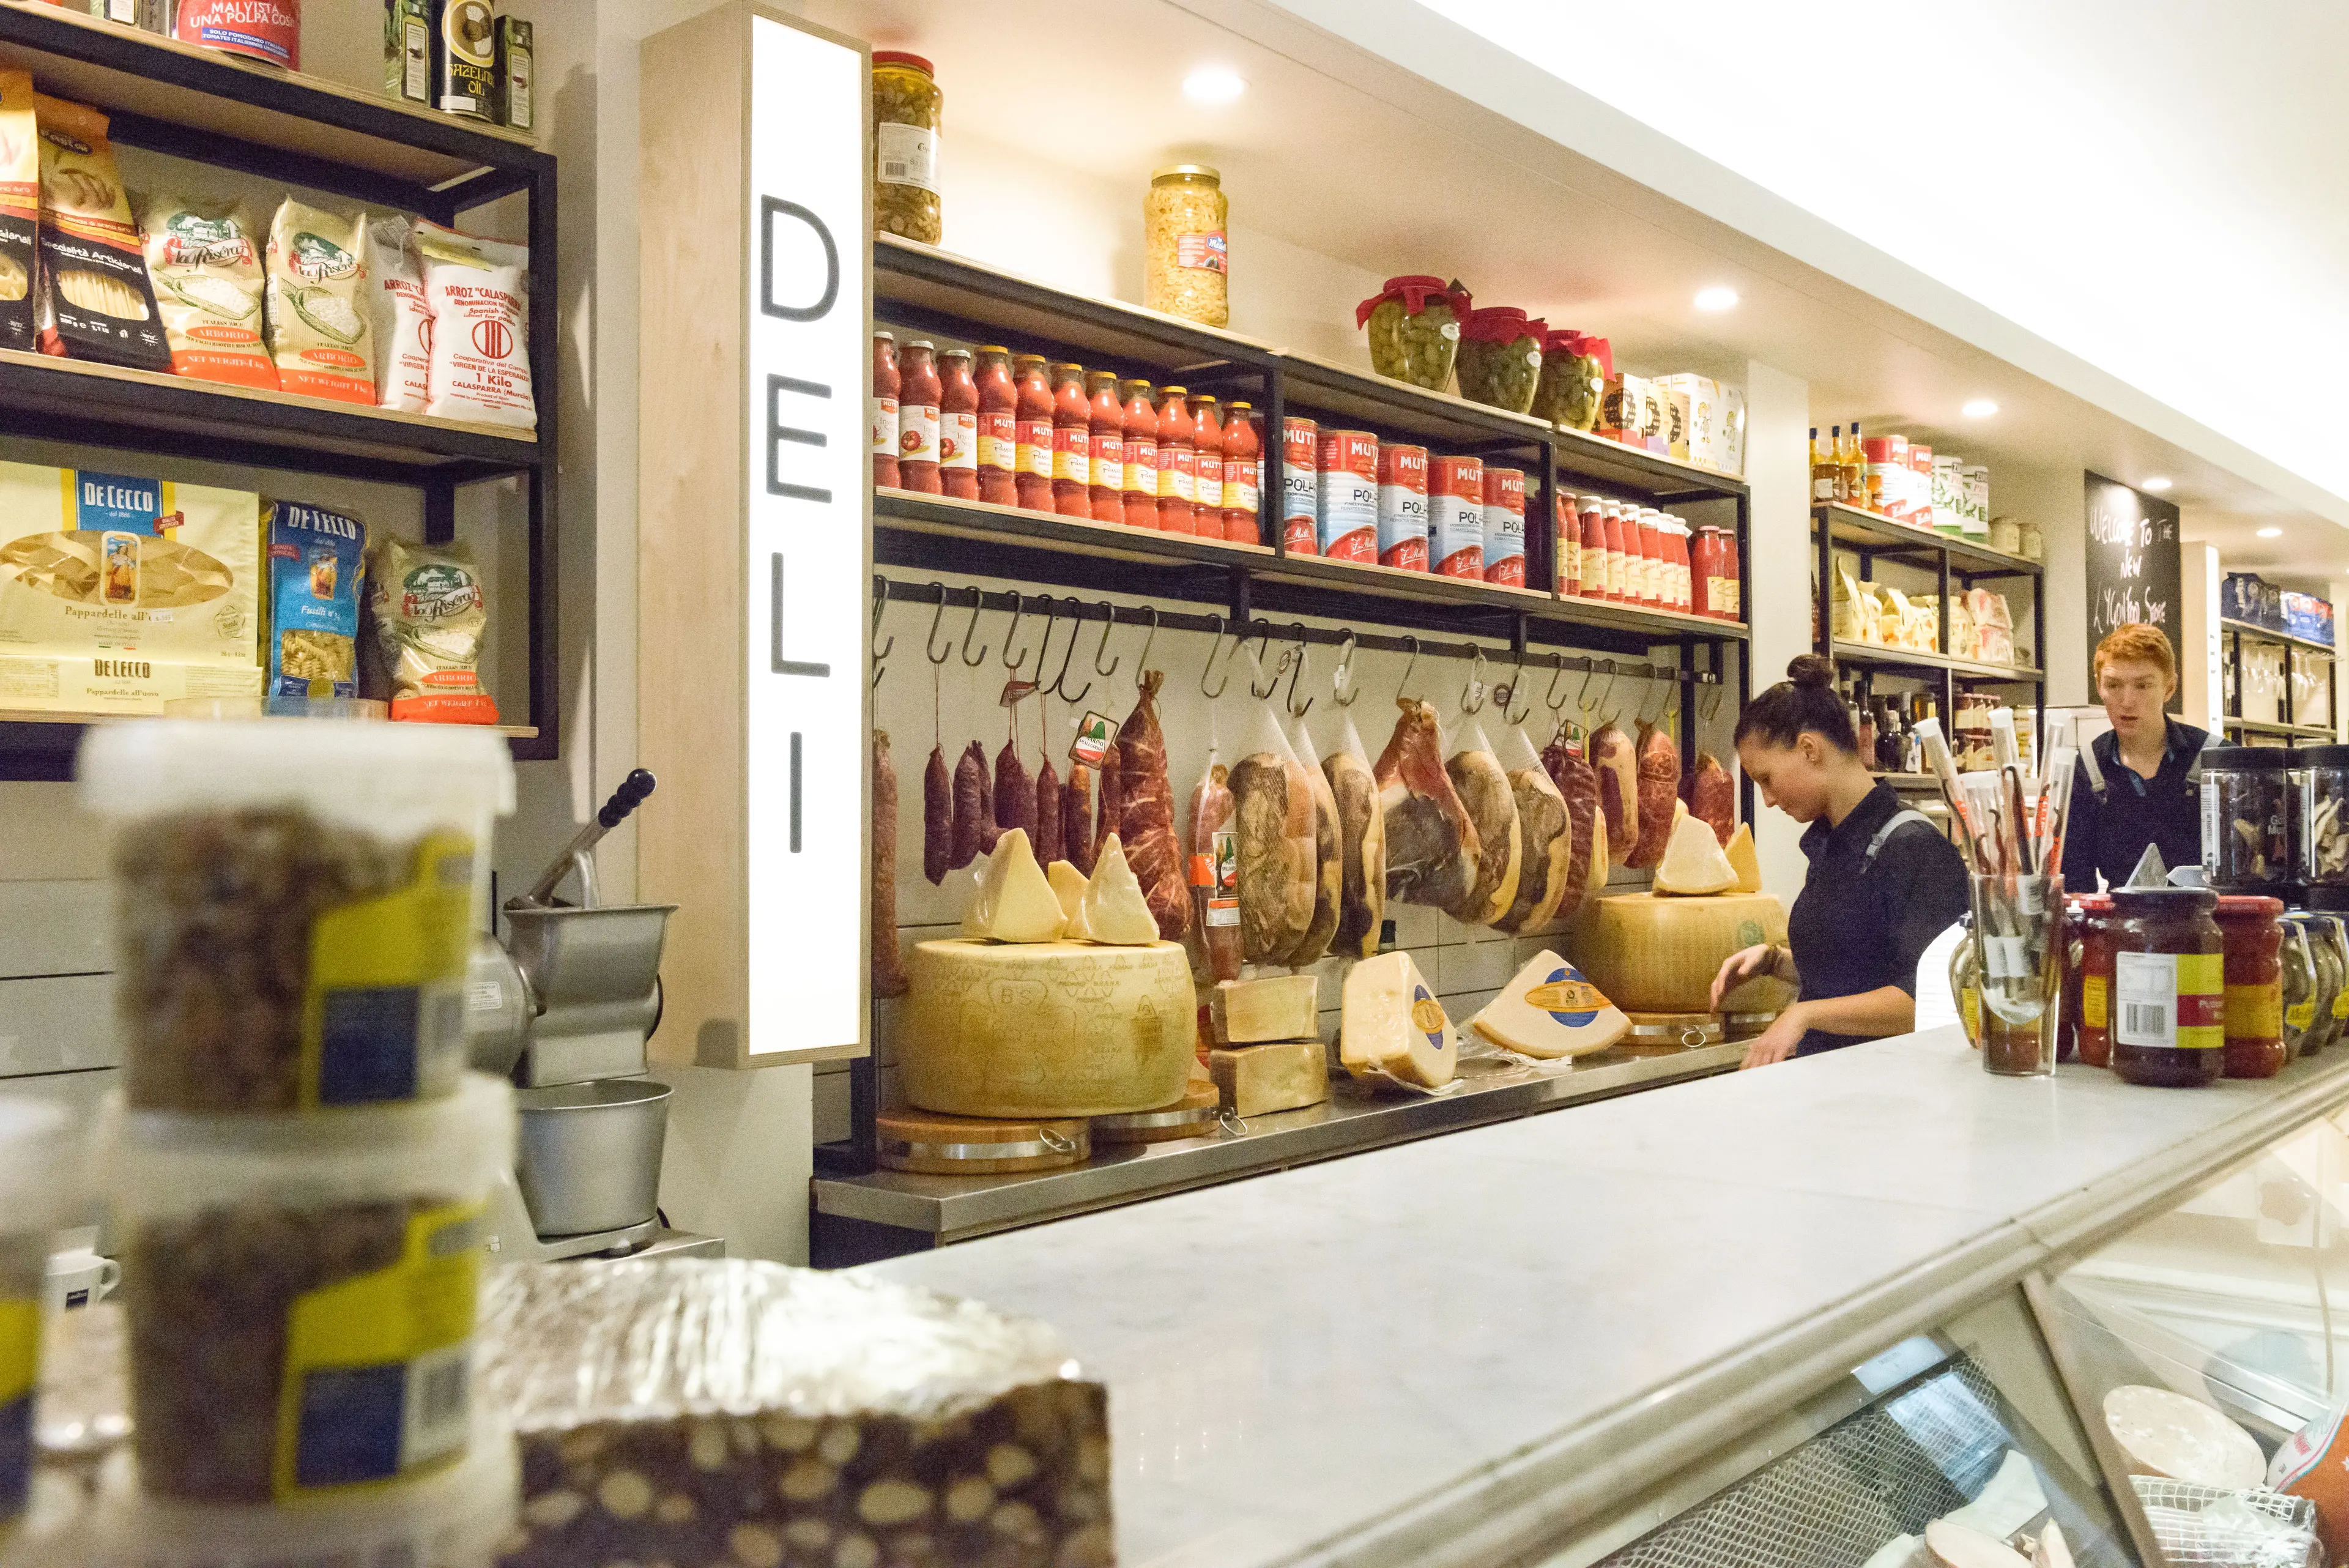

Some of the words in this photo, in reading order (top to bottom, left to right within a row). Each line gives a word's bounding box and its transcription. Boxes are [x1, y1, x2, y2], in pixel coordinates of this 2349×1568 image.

[211, 2, 240, 14] MAI
[243, 2, 279, 14] VISTA
[190, 14, 222, 28] UNA
[226, 12, 269, 24] POLPA
[203, 33, 231, 42] TOMATES
[231, 37, 263, 49] ITALIENNES
[229, 32, 264, 44] POMODORO
[468, 80, 485, 97] OIL
[92, 251, 144, 275] Artigianali
[384, 279, 412, 292] ARROZ
[445, 285, 474, 299] ARROZ
[199, 329, 250, 340] ARBORIO
[313, 351, 358, 364] ARBORIO
[401, 353, 429, 364] Coopera
[453, 353, 494, 366] Cooperativa
[298, 374, 316, 384] NET
[476, 372, 481, 383] 1
[488, 374, 513, 388] Kilo
[452, 380, 502, 394] CALASPARRA
[503, 388, 531, 403] (Murcia)
[994, 418, 1015, 430] MUTT
[1033, 426, 1053, 438] MUTT
[1070, 433, 1089, 444] MUTT
[1283, 429, 1316, 448] MUTT
[1102, 441, 1123, 451] MUTT
[1140, 447, 1157, 457] MUTT
[1178, 454, 1193, 463] MUT
[1201, 460, 1222, 470] MUTT
[1400, 456, 1428, 472] MUTT
[1242, 467, 1257, 475] MUT
[1457, 467, 1483, 483] MUTT
[1284, 478, 1315, 492] POLP
[1502, 478, 1524, 493] MUT
[84, 481, 105, 507] DE
[107, 485, 153, 513] CECCO
[288, 506, 310, 530] DE
[311, 510, 356, 541] CECCO
[760, 194, 840, 853] DELI
[2139, 517, 2153, 548] TO
[2156, 519, 2173, 543] THE
[2120, 548, 2142, 579] NEW
[65, 605, 128, 620] Pappardelle
[132, 611, 152, 621] all'
[300, 604, 327, 616] Fusilli
[94, 659, 110, 677] DE
[113, 660, 150, 679] CECCO
[86, 687, 129, 697] Pappardelle
[1078, 738, 1104, 752] SMALLGOODS
[1085, 736, 1105, 747] MARINO
